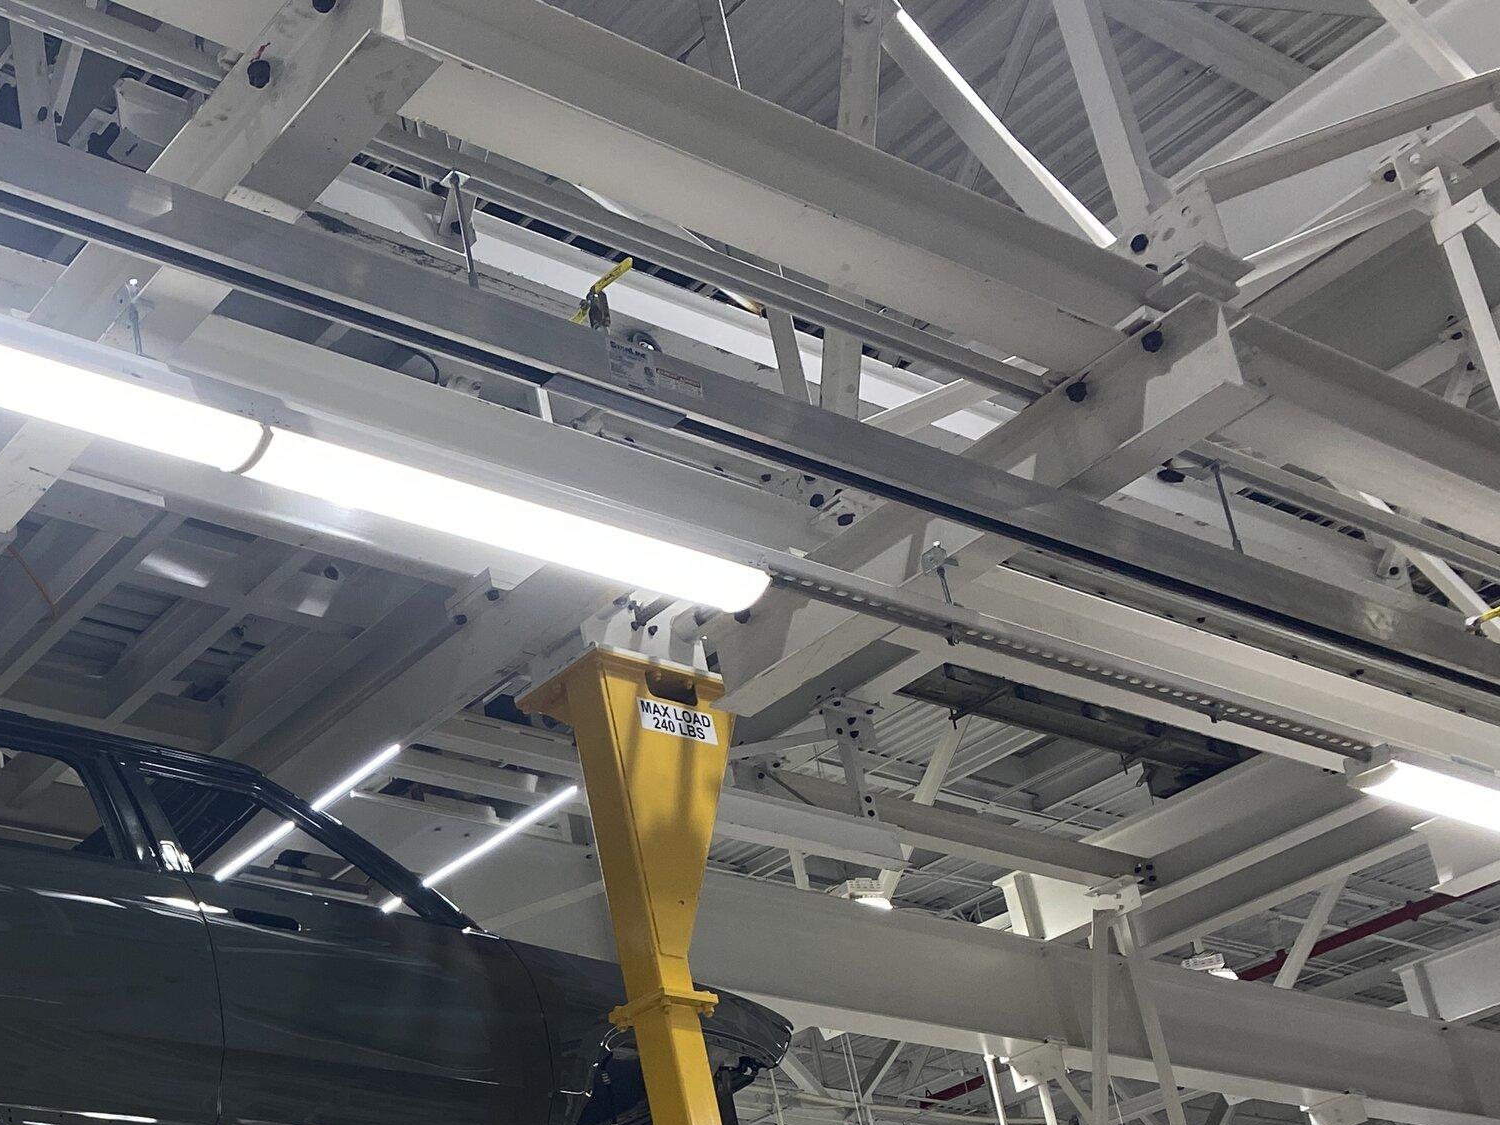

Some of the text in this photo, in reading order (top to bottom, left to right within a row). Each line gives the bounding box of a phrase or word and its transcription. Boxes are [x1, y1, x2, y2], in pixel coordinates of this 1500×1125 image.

[640, 700, 711, 728] MAX LOAD
[653, 717, 705, 740] 240 LBS
